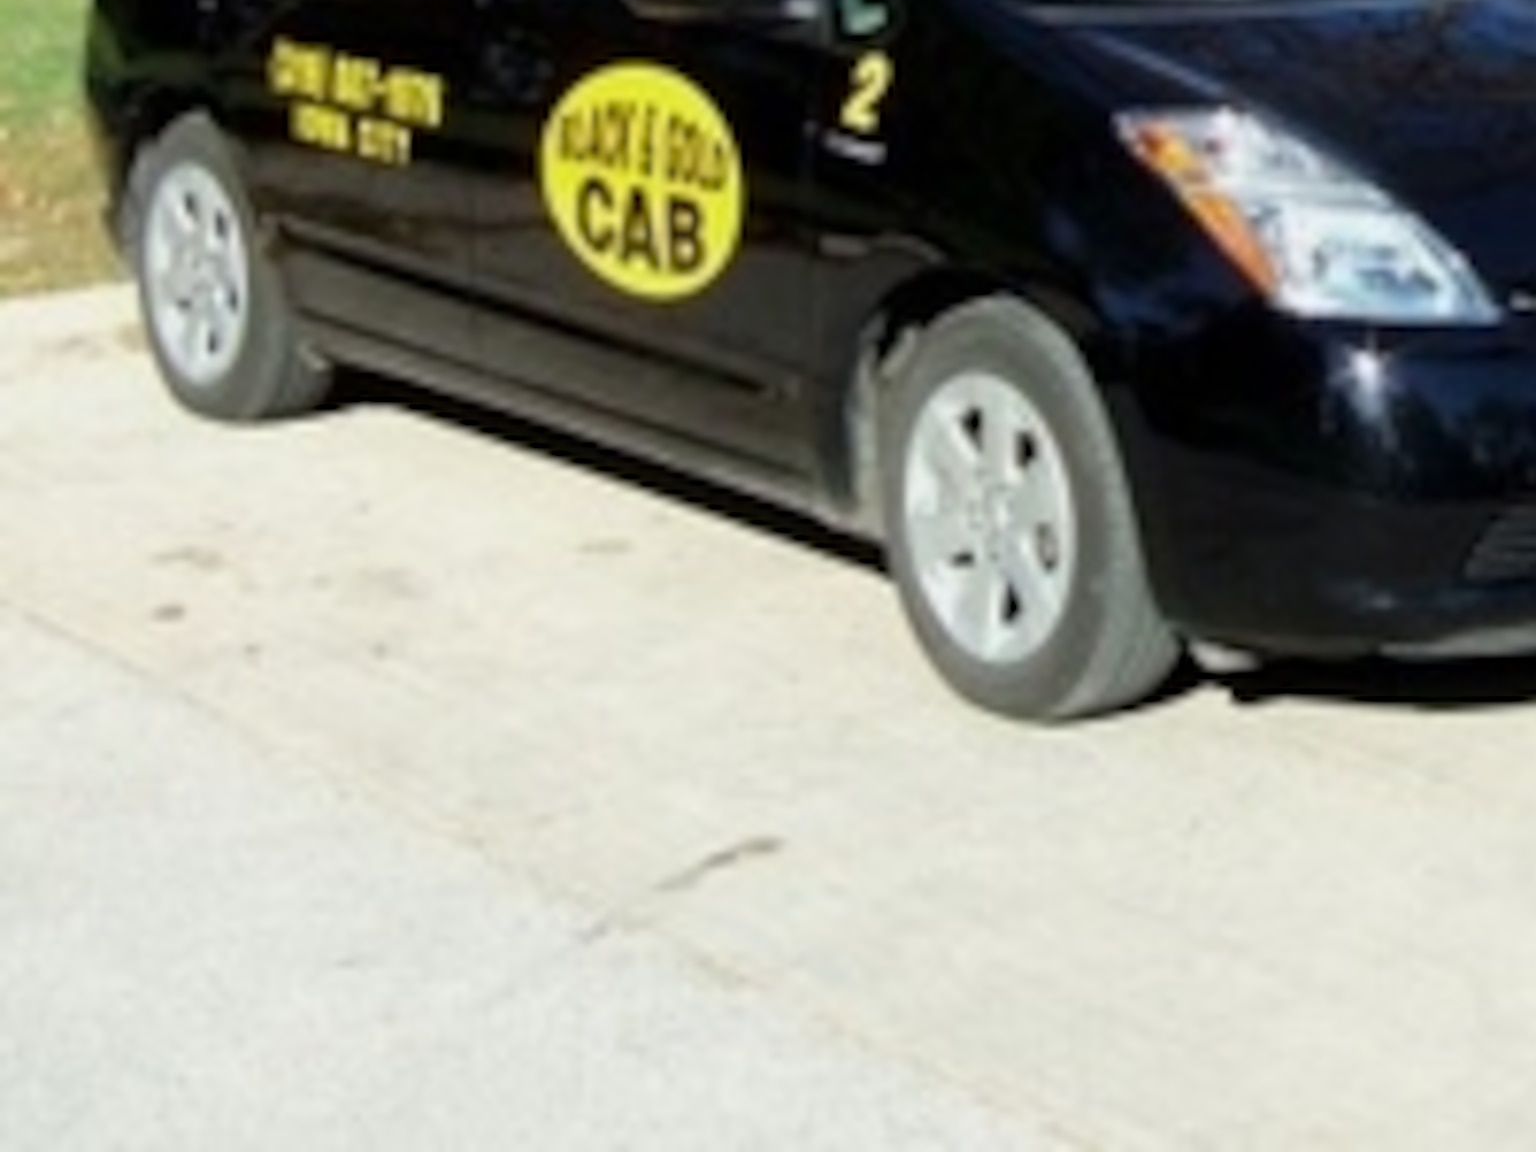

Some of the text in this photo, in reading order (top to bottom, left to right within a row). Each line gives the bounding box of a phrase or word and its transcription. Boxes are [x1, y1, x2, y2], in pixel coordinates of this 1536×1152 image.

[842, 50, 894, 132] 2
[558, 101, 638, 174] BLACK
[663, 112, 729, 192] GOLD
[576, 177, 704, 275] CAB
